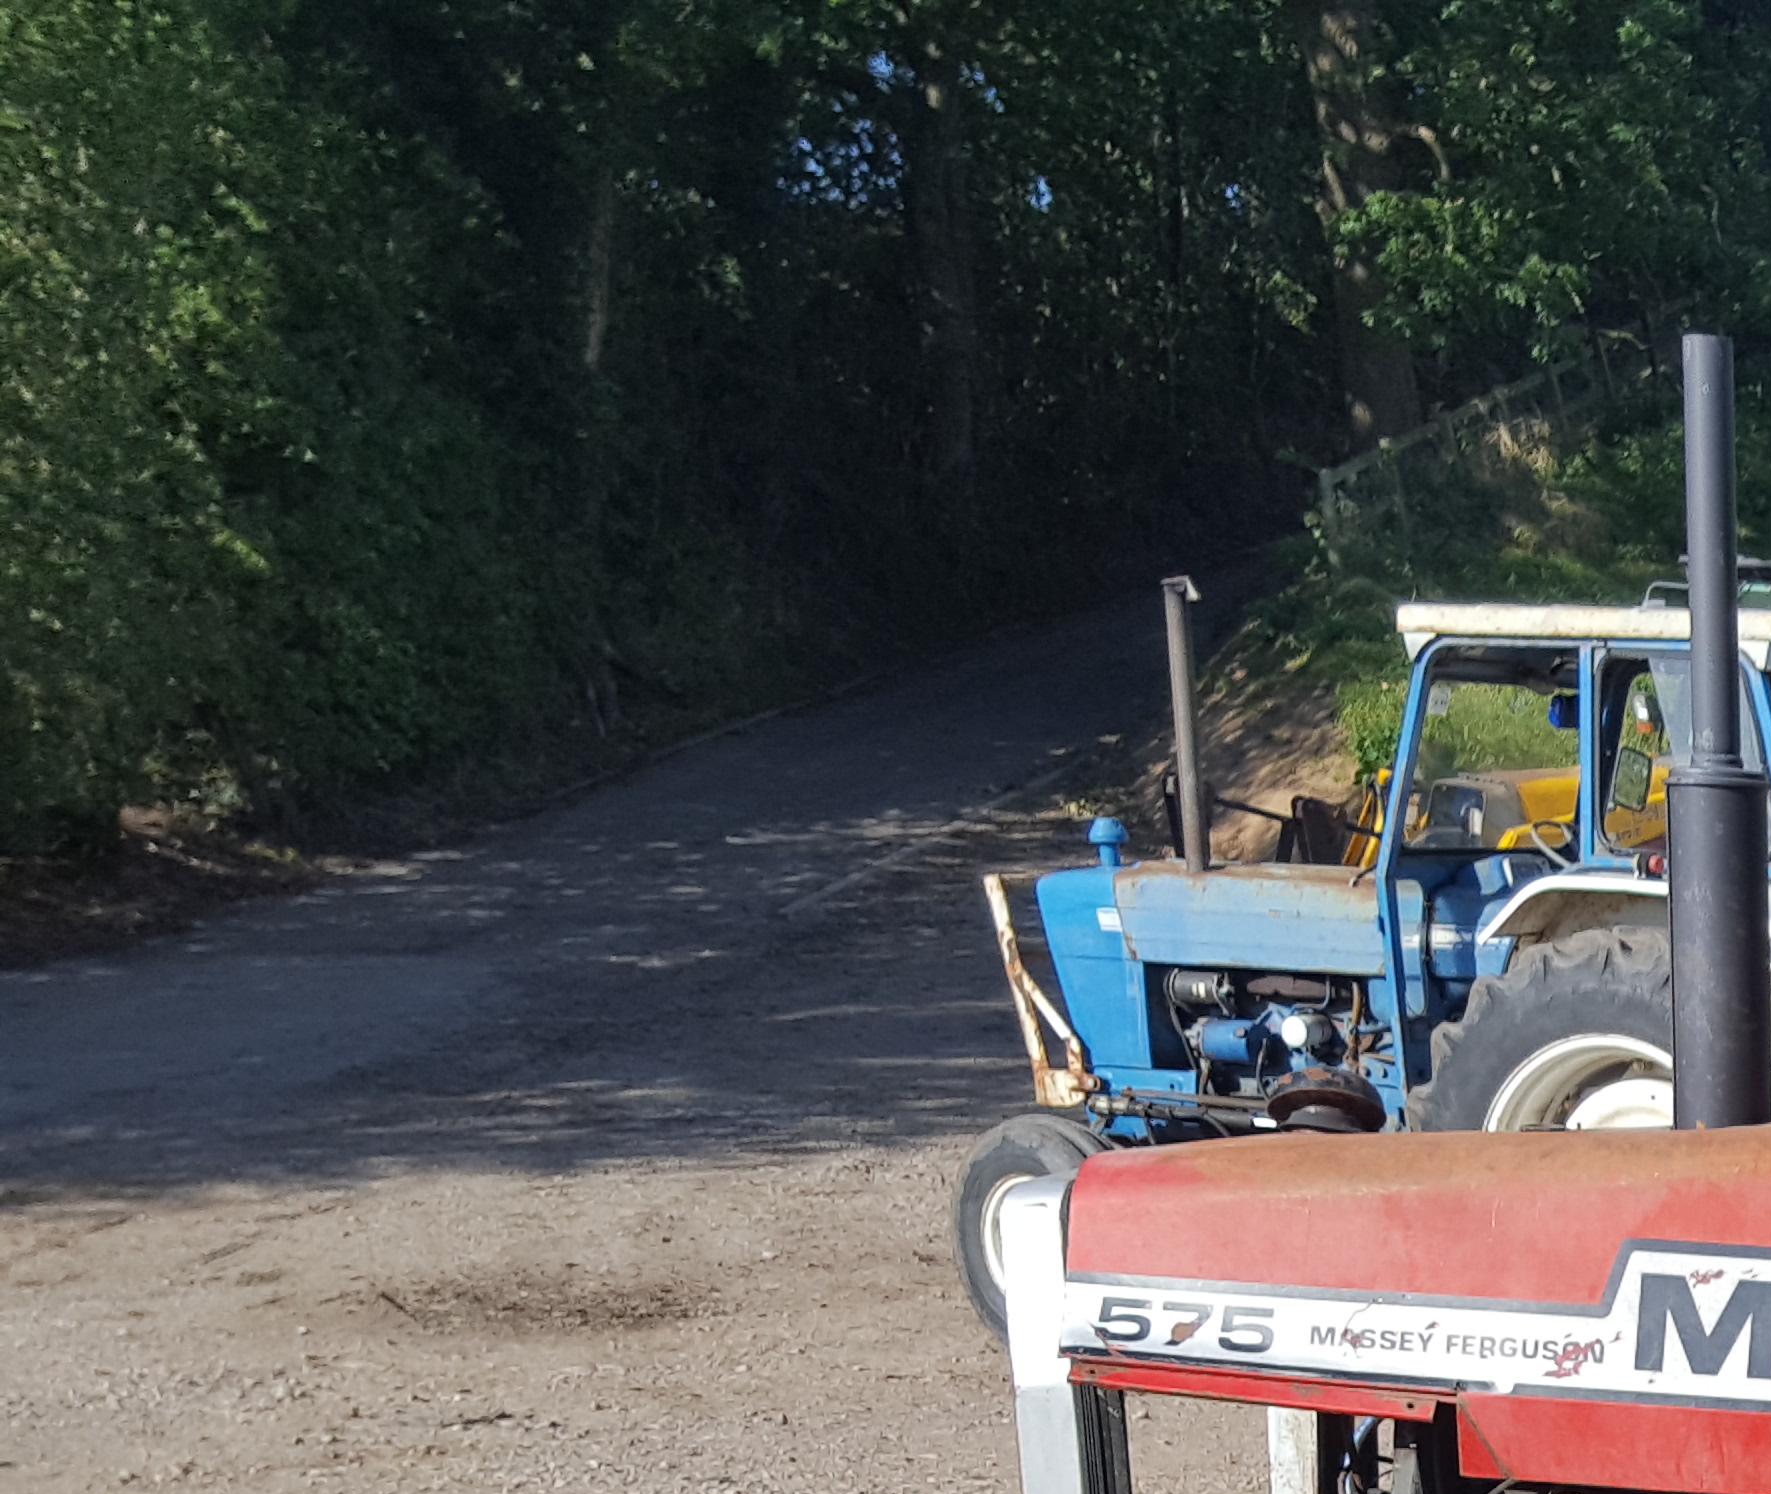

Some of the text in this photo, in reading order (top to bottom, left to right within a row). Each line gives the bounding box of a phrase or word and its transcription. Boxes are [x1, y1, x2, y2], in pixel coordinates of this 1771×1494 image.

[1096, 1296, 1275, 1353] 575
[1310, 1325, 1434, 1352] MASSEY
[1446, 1334, 1605, 1364] FERGUSON
